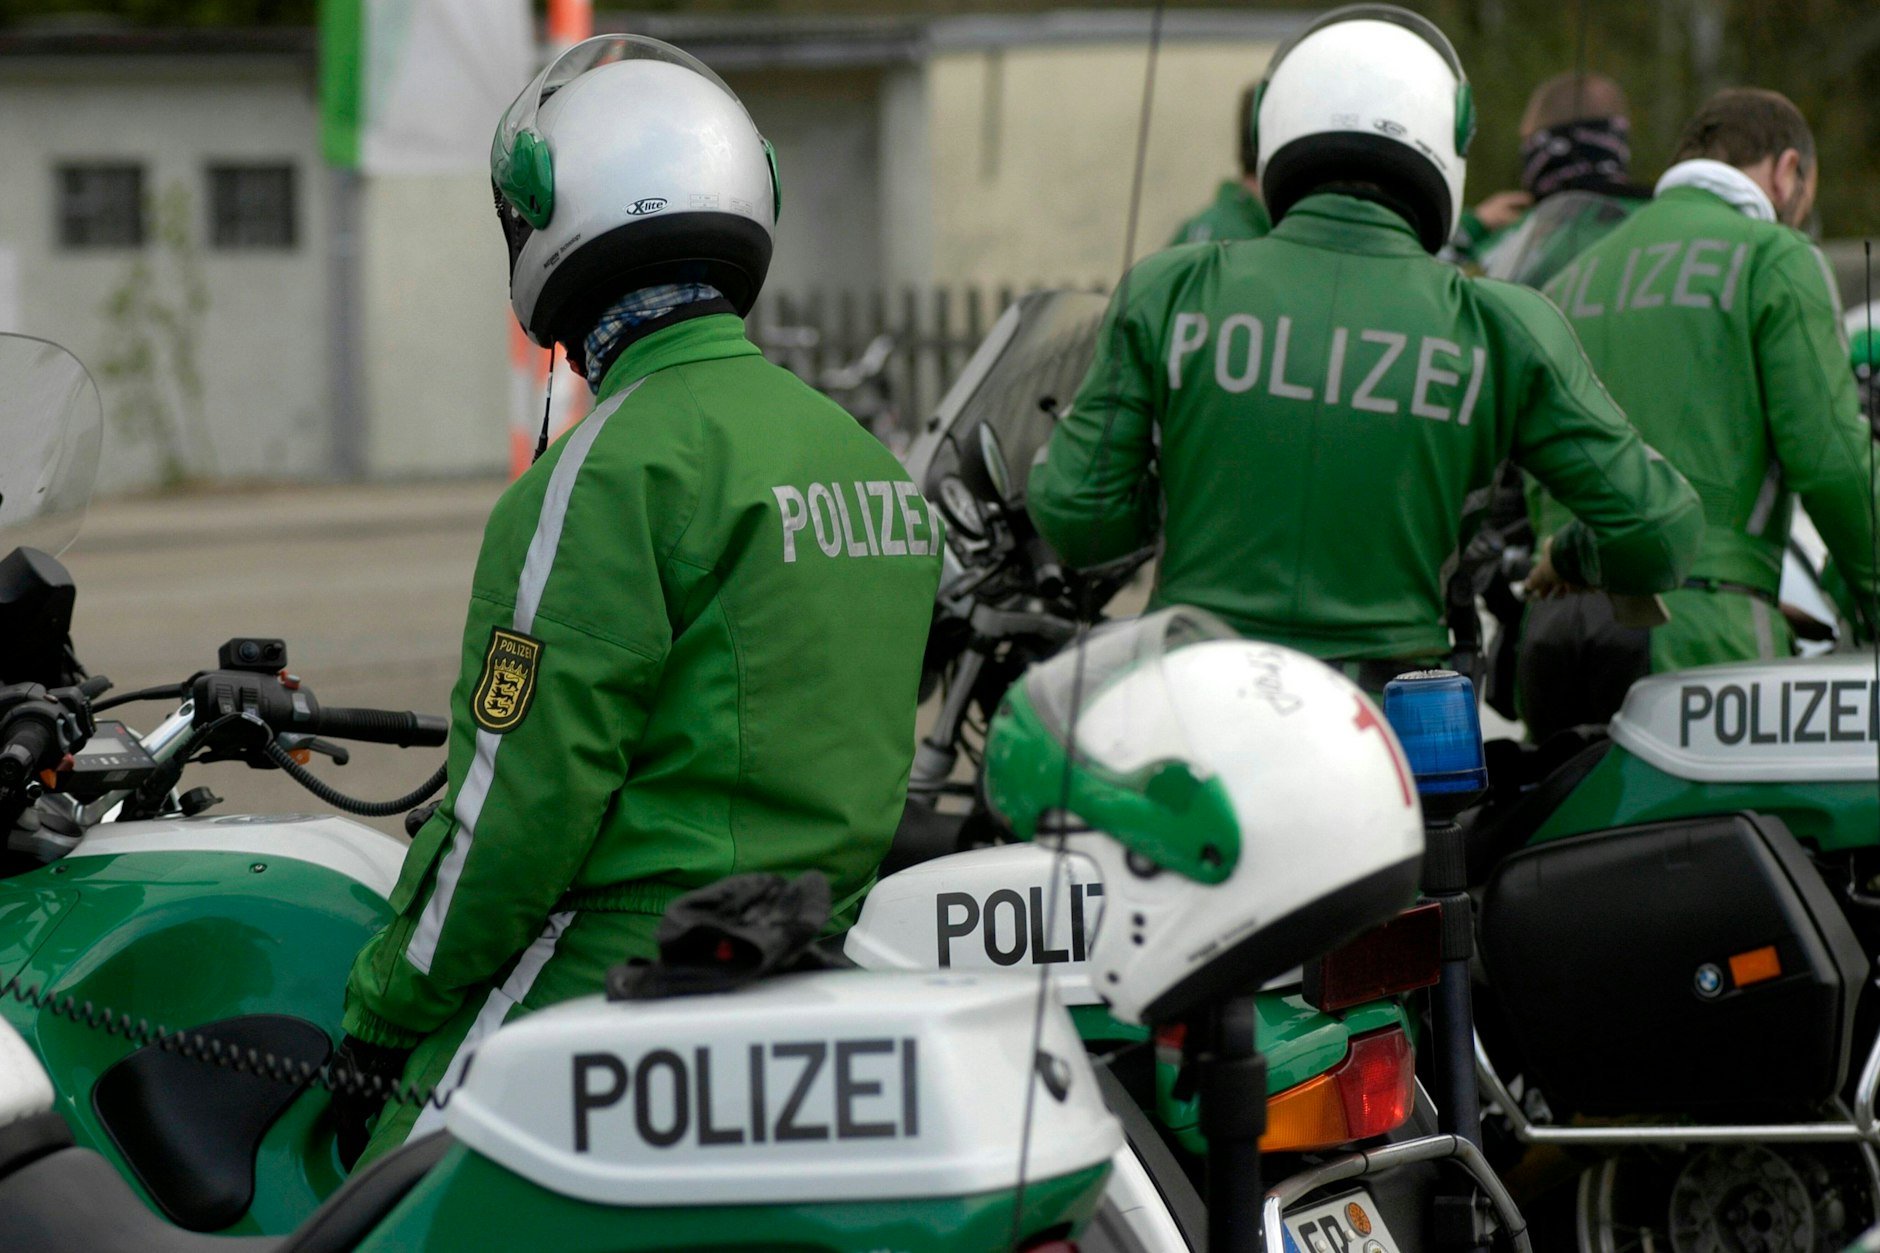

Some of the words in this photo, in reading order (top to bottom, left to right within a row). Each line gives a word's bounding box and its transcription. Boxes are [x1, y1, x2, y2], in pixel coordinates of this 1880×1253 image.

[630, 198, 665, 215] X-lite
[1546, 239, 1746, 318] LIZEI
[1168, 312, 1486, 426] POLIZEI
[771, 480, 940, 563] POLIZEI
[500, 639, 532, 659] POLIZEI
[1680, 680, 1880, 748] POLIZEI
[936, 883, 1104, 969] POLI
[572, 1038, 920, 1154] POLIZEI
